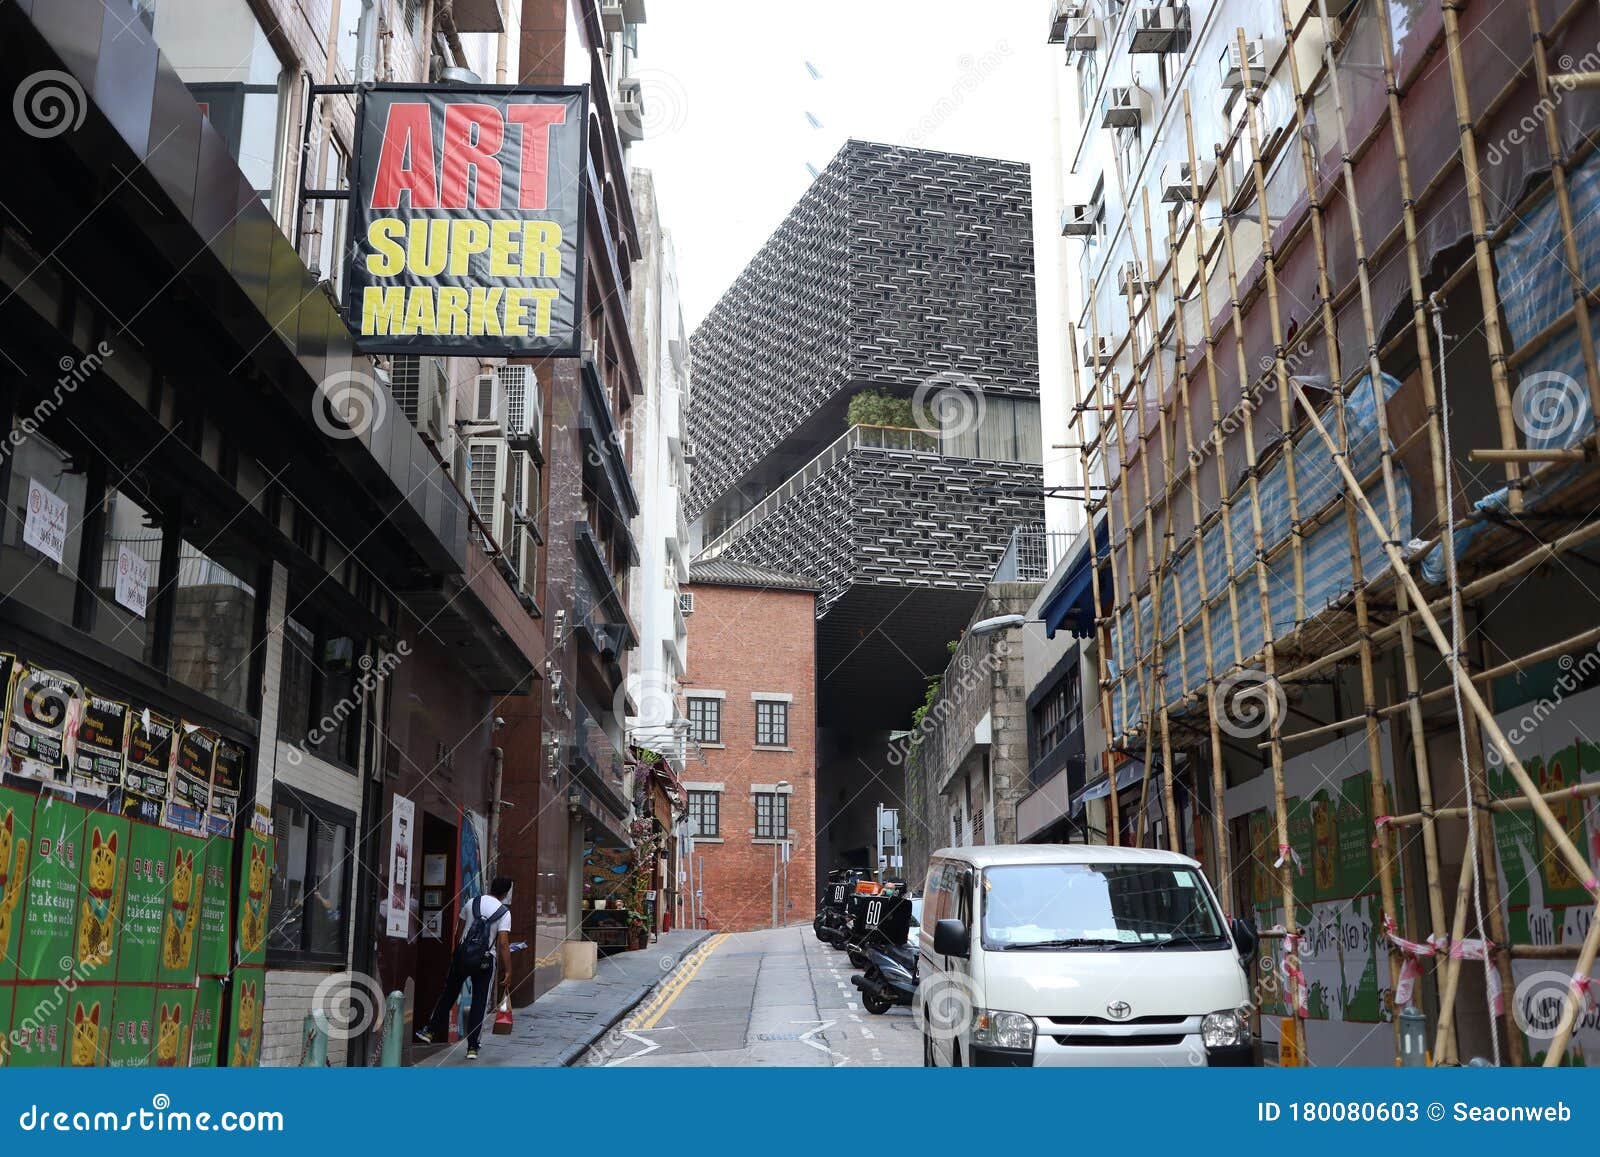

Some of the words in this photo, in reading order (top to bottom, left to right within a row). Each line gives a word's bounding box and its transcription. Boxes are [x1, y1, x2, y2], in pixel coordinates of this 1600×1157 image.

[370, 103, 567, 210] ART
[367, 218, 563, 278] SUPER
[361, 286, 560, 337] MARKET
[866, 900, 882, 926] GO
